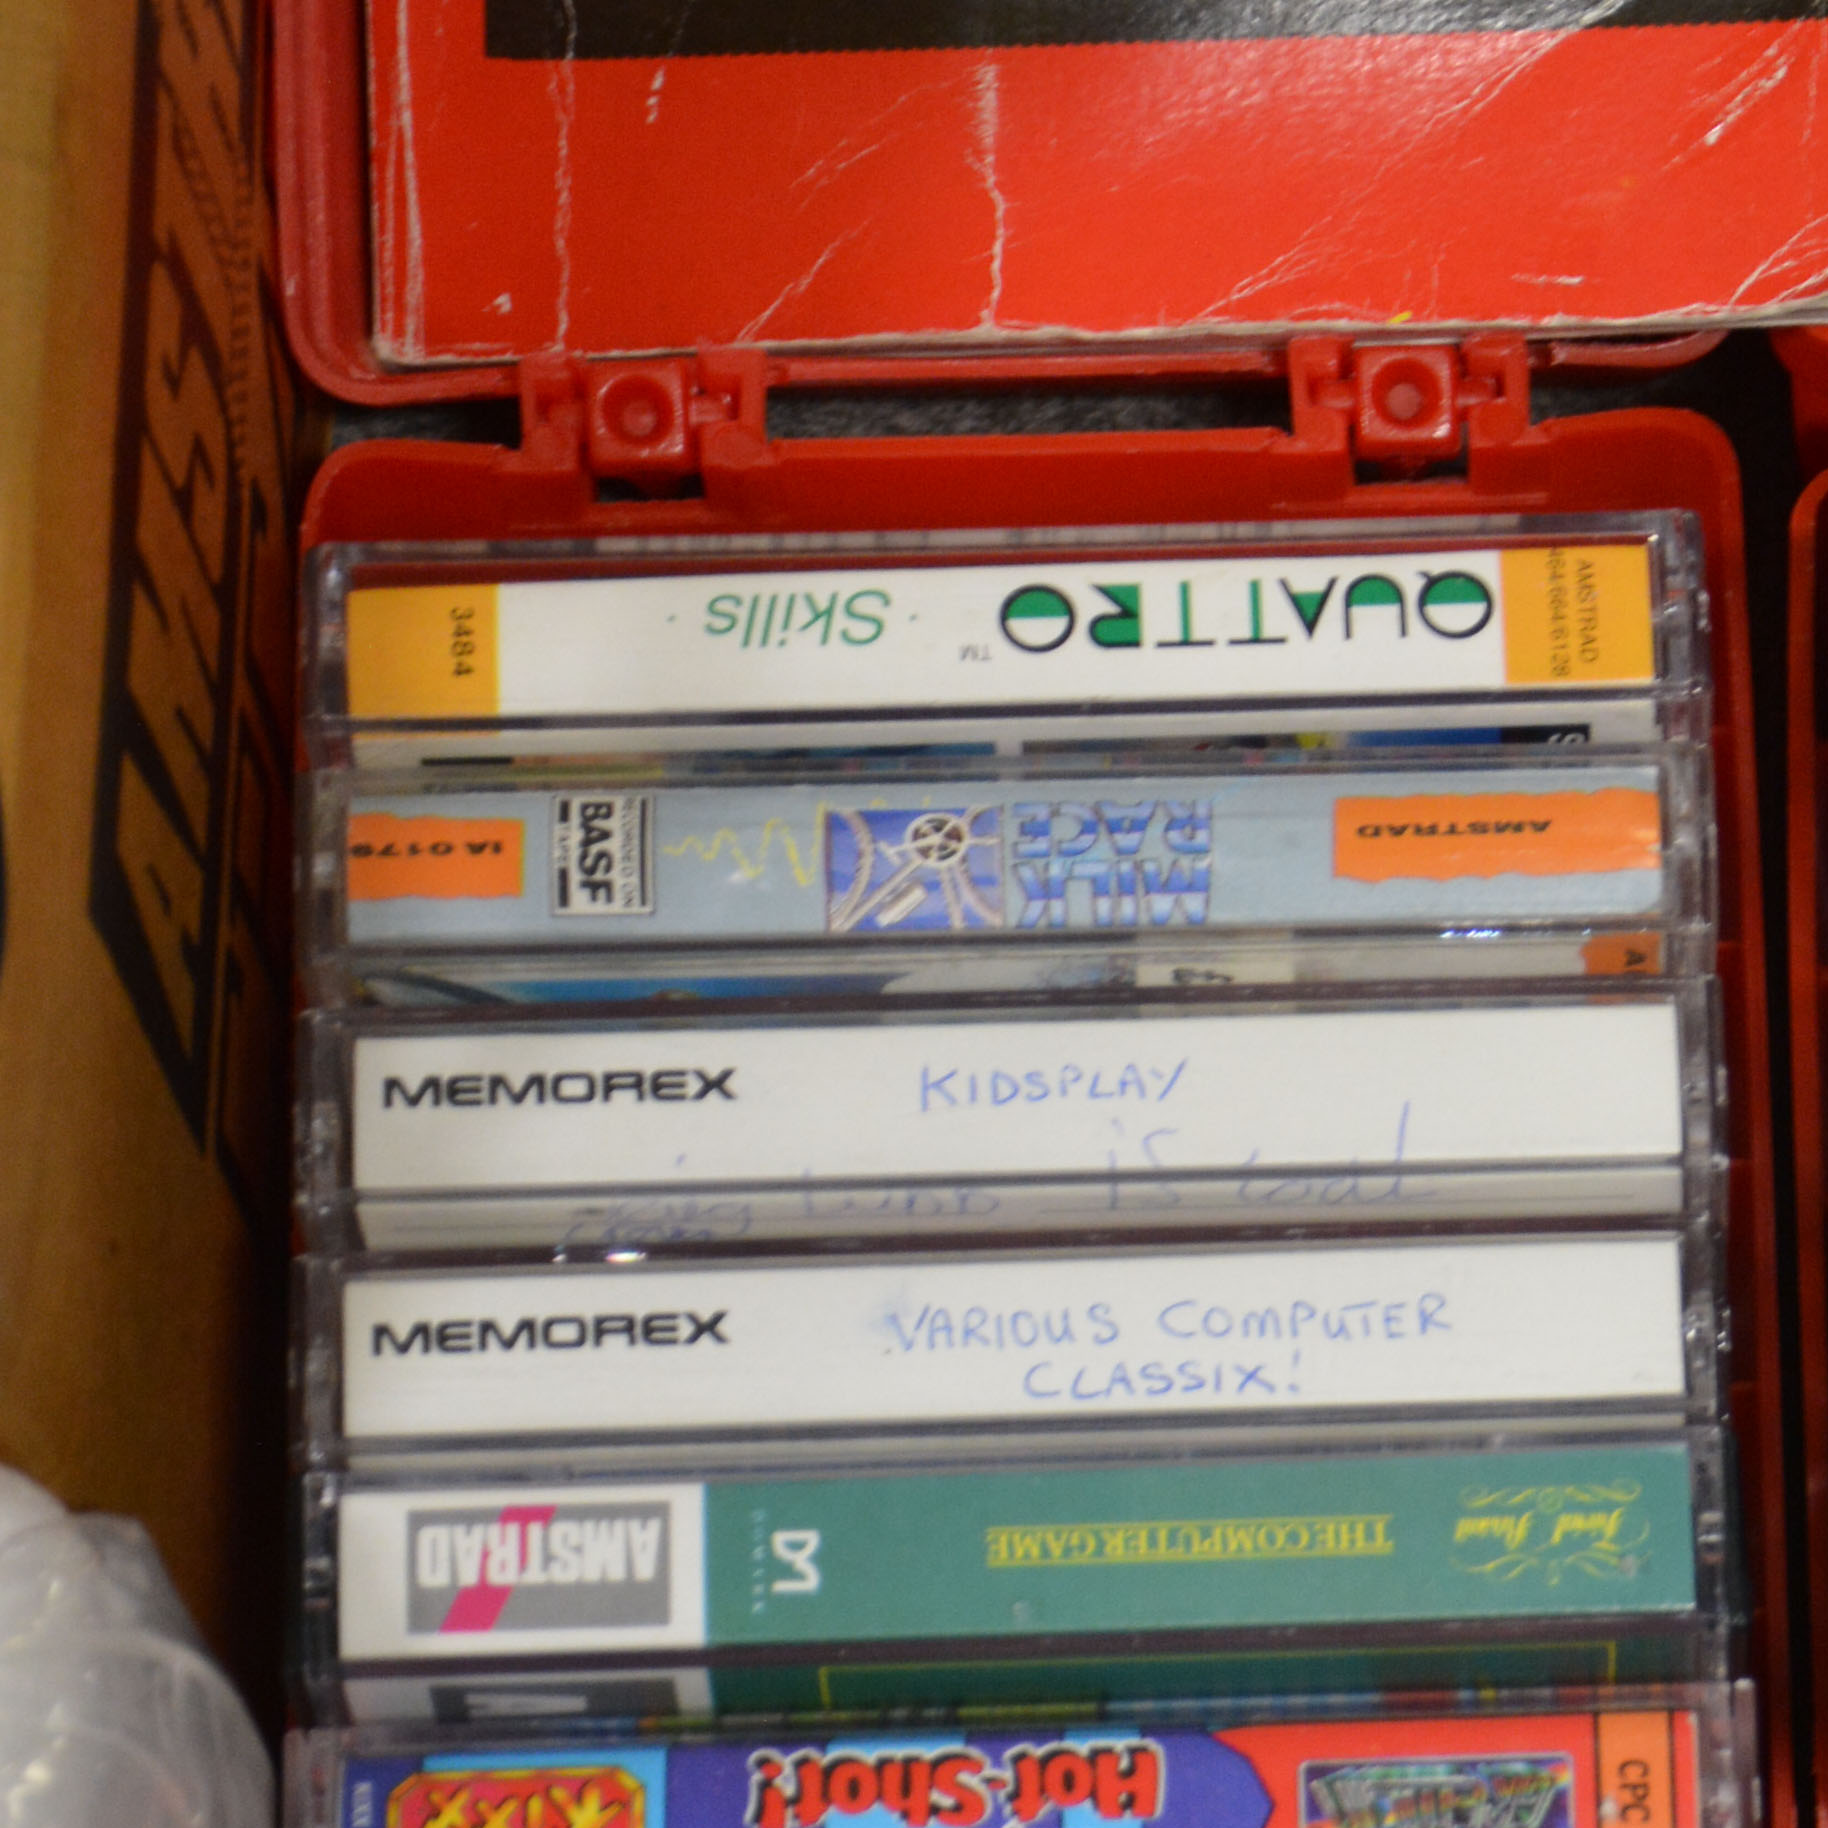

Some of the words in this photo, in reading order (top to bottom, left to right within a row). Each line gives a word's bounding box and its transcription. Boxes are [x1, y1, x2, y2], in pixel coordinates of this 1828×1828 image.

[704, 588, 892, 649] Skills
[1000, 569, 1493, 653] QUATTRO
[1576, 558, 1598, 664] AMSTRAD
[449, 606, 476, 679] 3484
[578, 801, 617, 906] BASF
[1012, 802, 1211, 857] RACE
[1356, 818, 1552, 838] AMSTRAD
[1014, 858, 1211, 927] MILK
[382, 1067, 739, 1111] MEMOREX
[919, 1057, 1188, 1113] KIDSPLAY
[370, 1309, 731, 1358] MEMOREX
[890, 1302, 1120, 1353] VARIOUS
[1157, 1291, 1453, 1343] COMPUTER
[1022, 1351, 1303, 1400] CLASSIX!
[415, 1516, 662, 1590] AMSTRAD
[986, 1526, 1096, 1561] GAME
[1103, 1523, 1308, 1557] COMPUTER
[1324, 1520, 1392, 1551] THE
[1617, 1758, 1650, 1825] CPC
